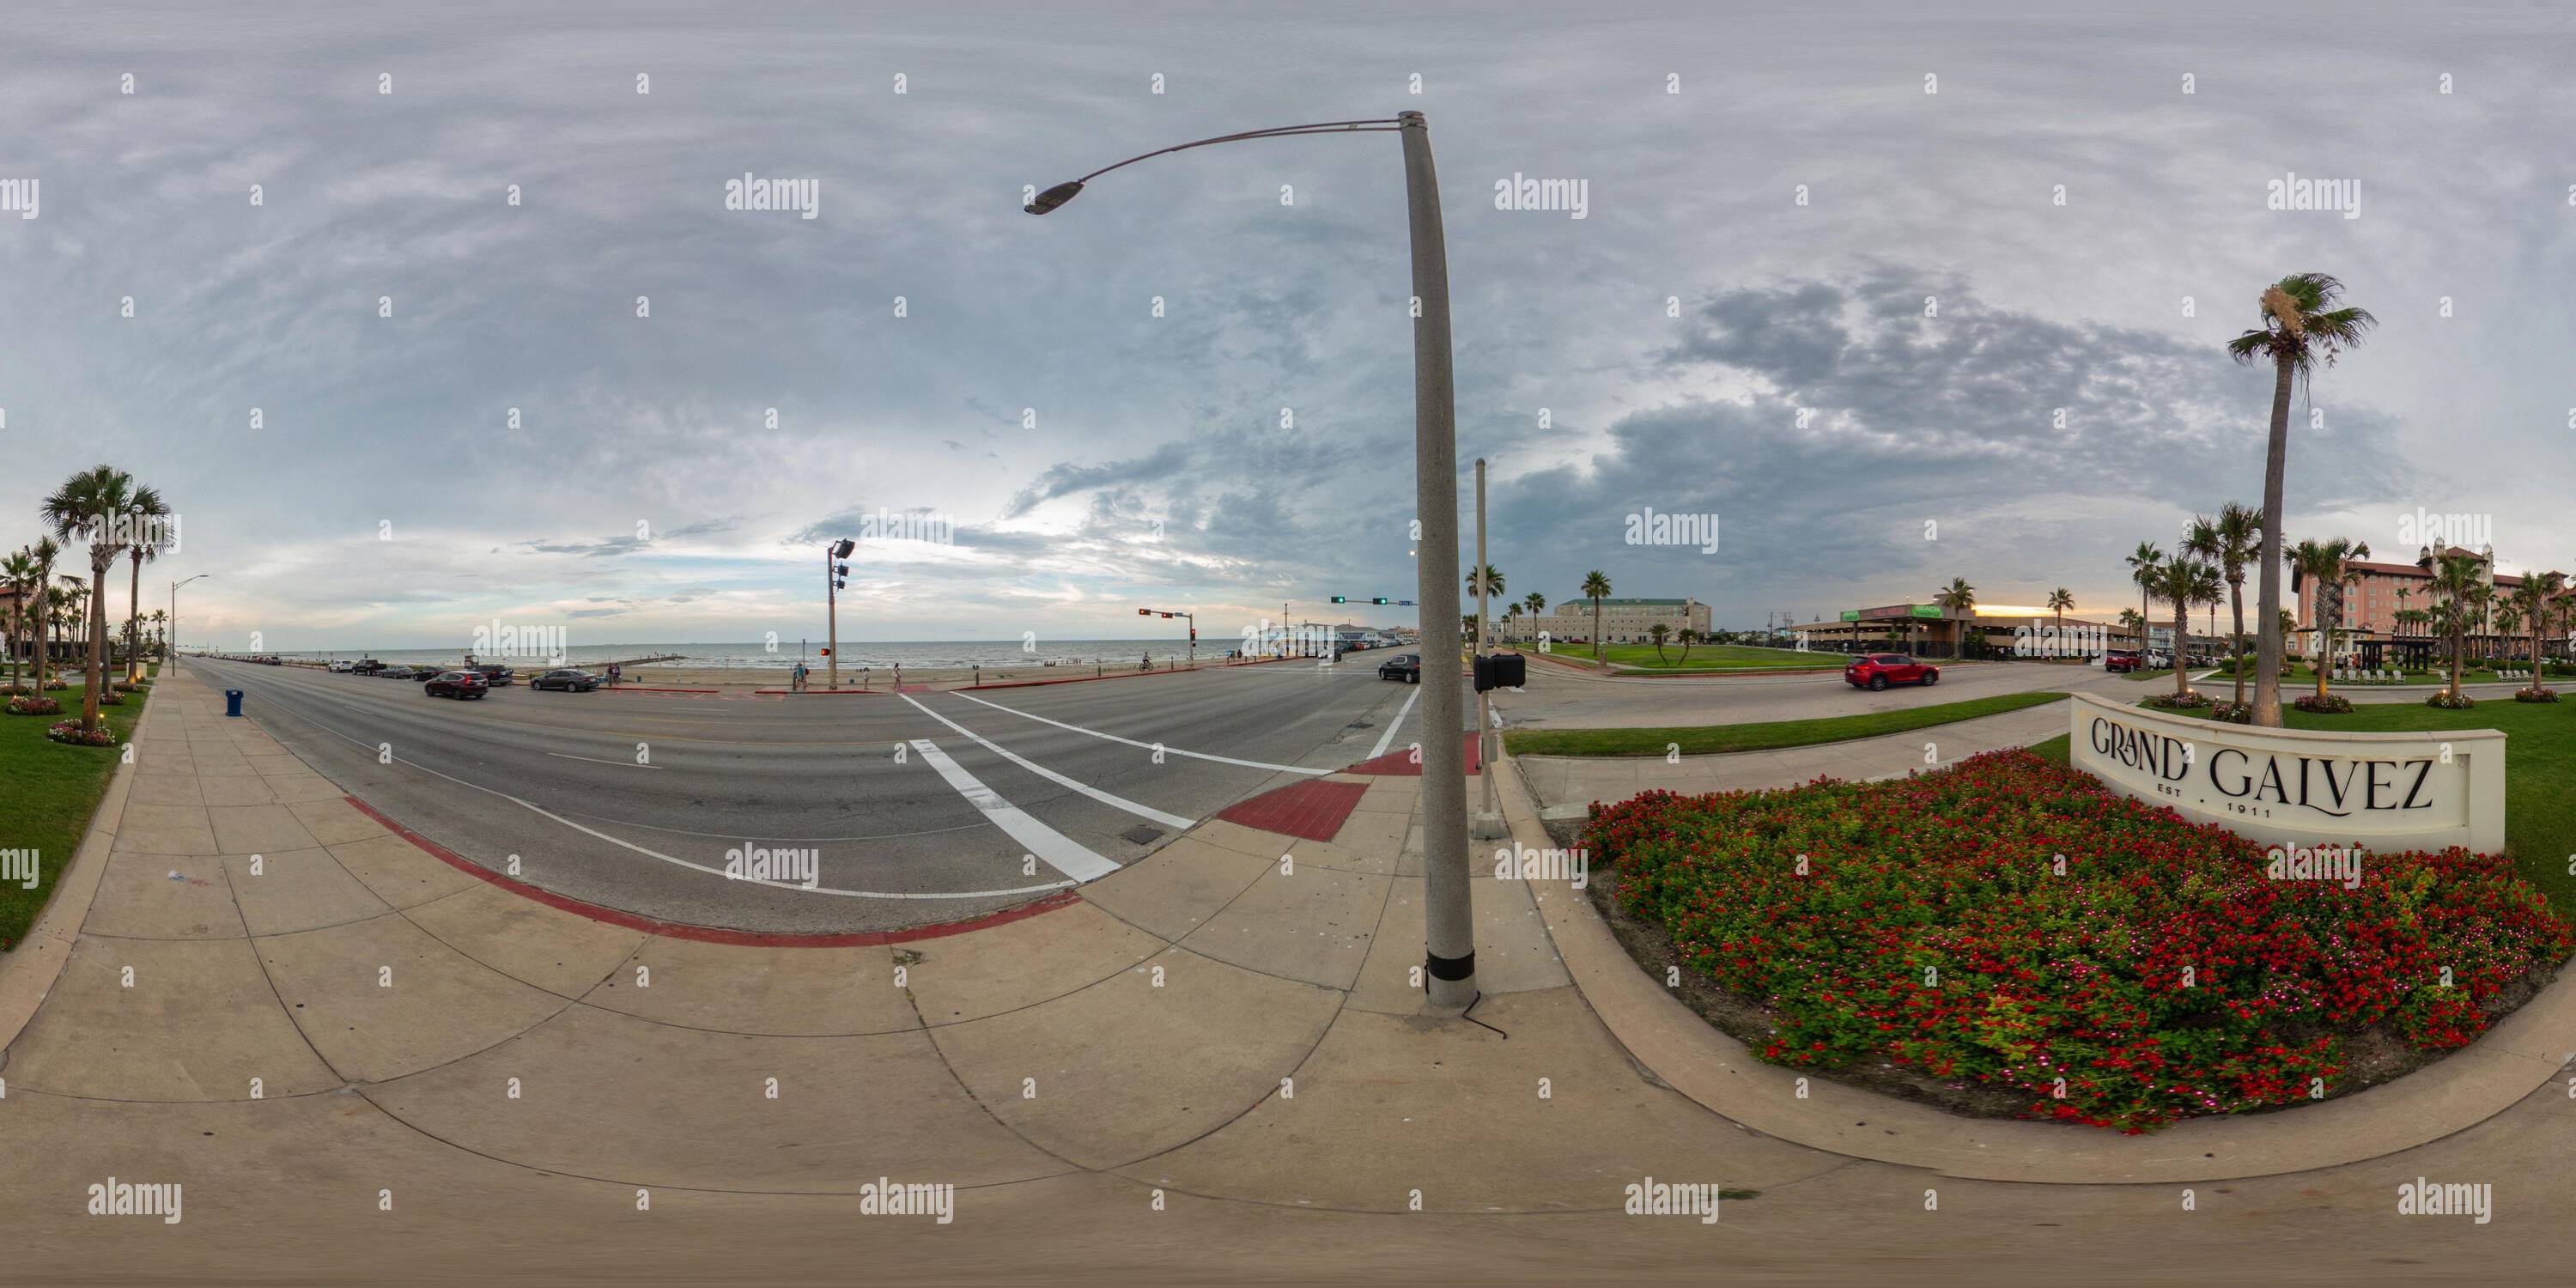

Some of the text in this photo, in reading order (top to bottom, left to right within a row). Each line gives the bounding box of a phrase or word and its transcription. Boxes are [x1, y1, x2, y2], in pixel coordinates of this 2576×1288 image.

[2092, 717, 2433, 817] GRAND GALVEZ
[2157, 783, 2269, 818] EST 1911
